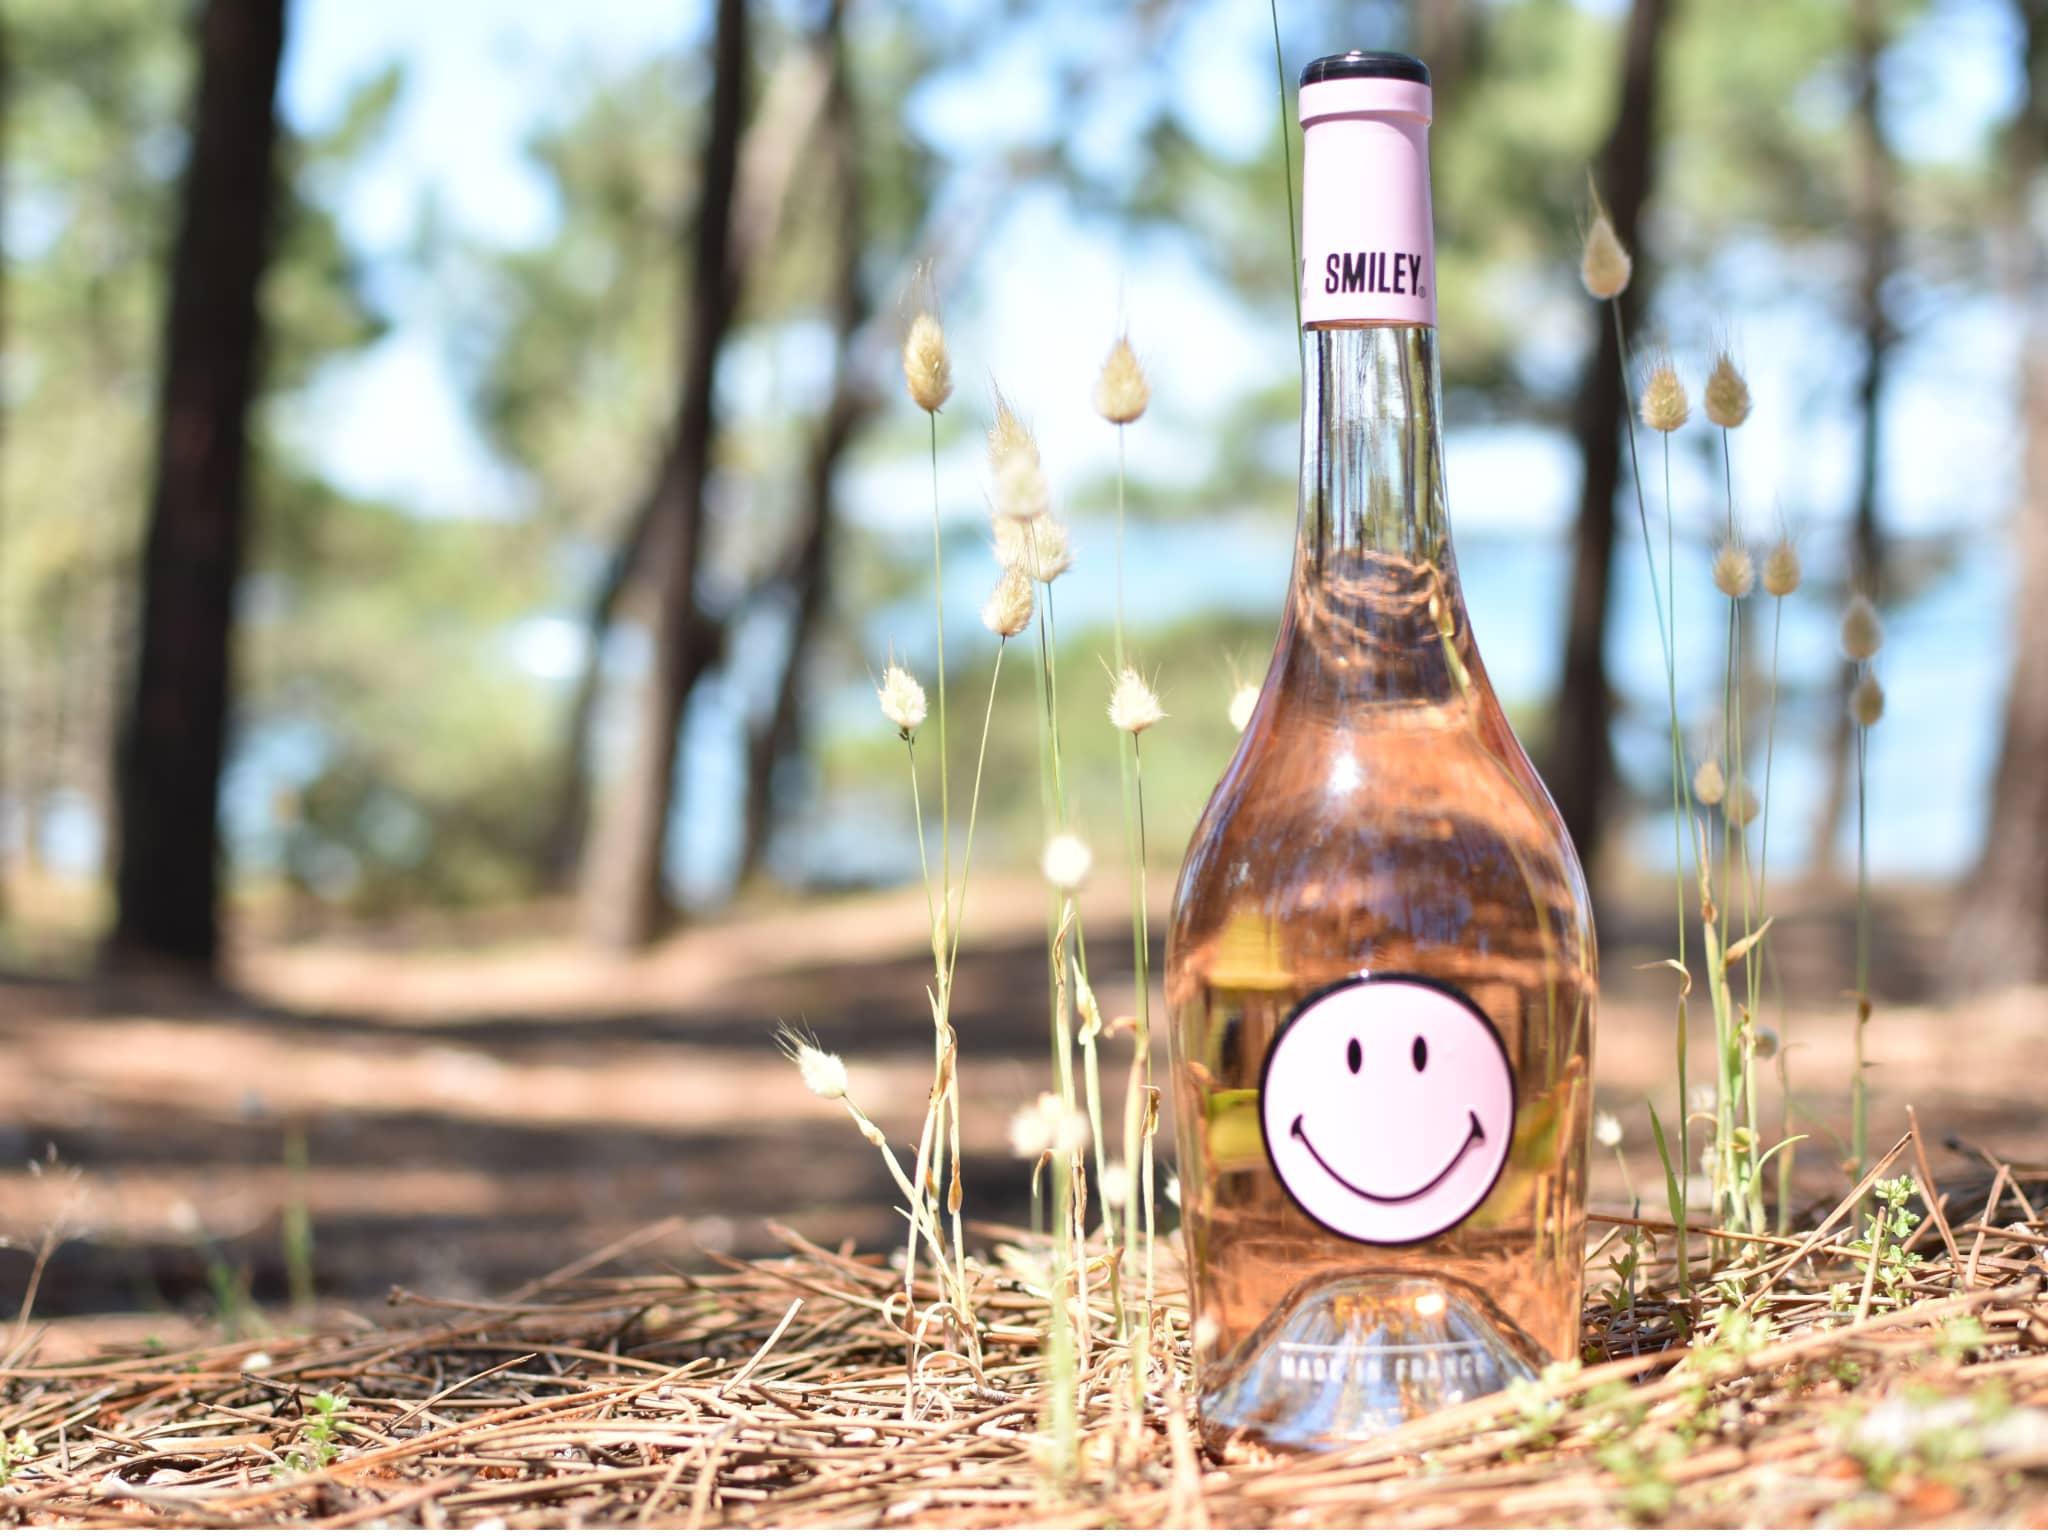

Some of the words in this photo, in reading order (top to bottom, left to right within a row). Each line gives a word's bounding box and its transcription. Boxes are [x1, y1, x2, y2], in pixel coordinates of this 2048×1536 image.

[1280, 1355, 1343, 1383] MADE
[1355, 1359, 1382, 1384] IN
[1395, 1353, 1488, 1382] FRANCE
